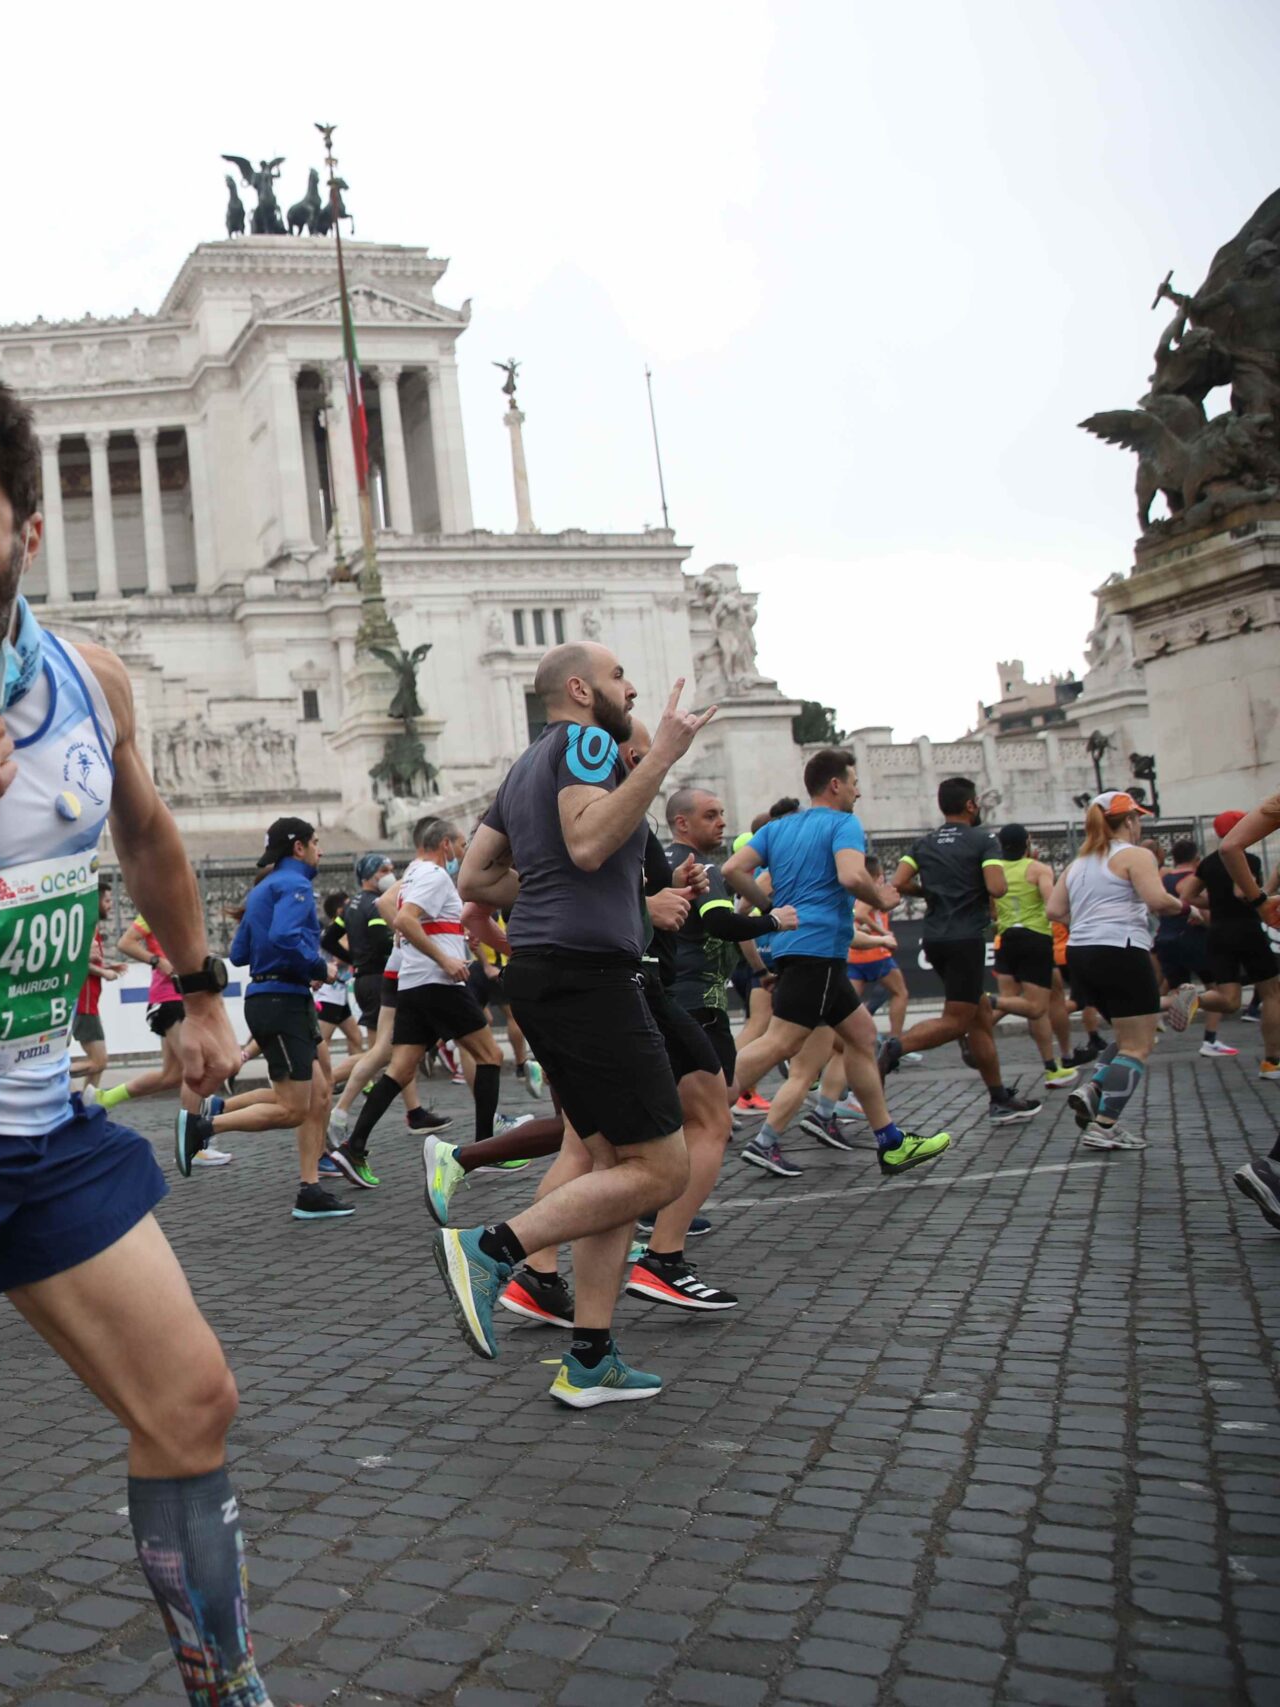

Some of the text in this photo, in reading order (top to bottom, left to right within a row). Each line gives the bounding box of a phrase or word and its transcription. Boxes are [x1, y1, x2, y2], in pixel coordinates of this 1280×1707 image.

[40, 866, 88, 894] acea
[8, 975, 60, 999] MAURIZIO
[0, 997, 68, 1039] 7 B
